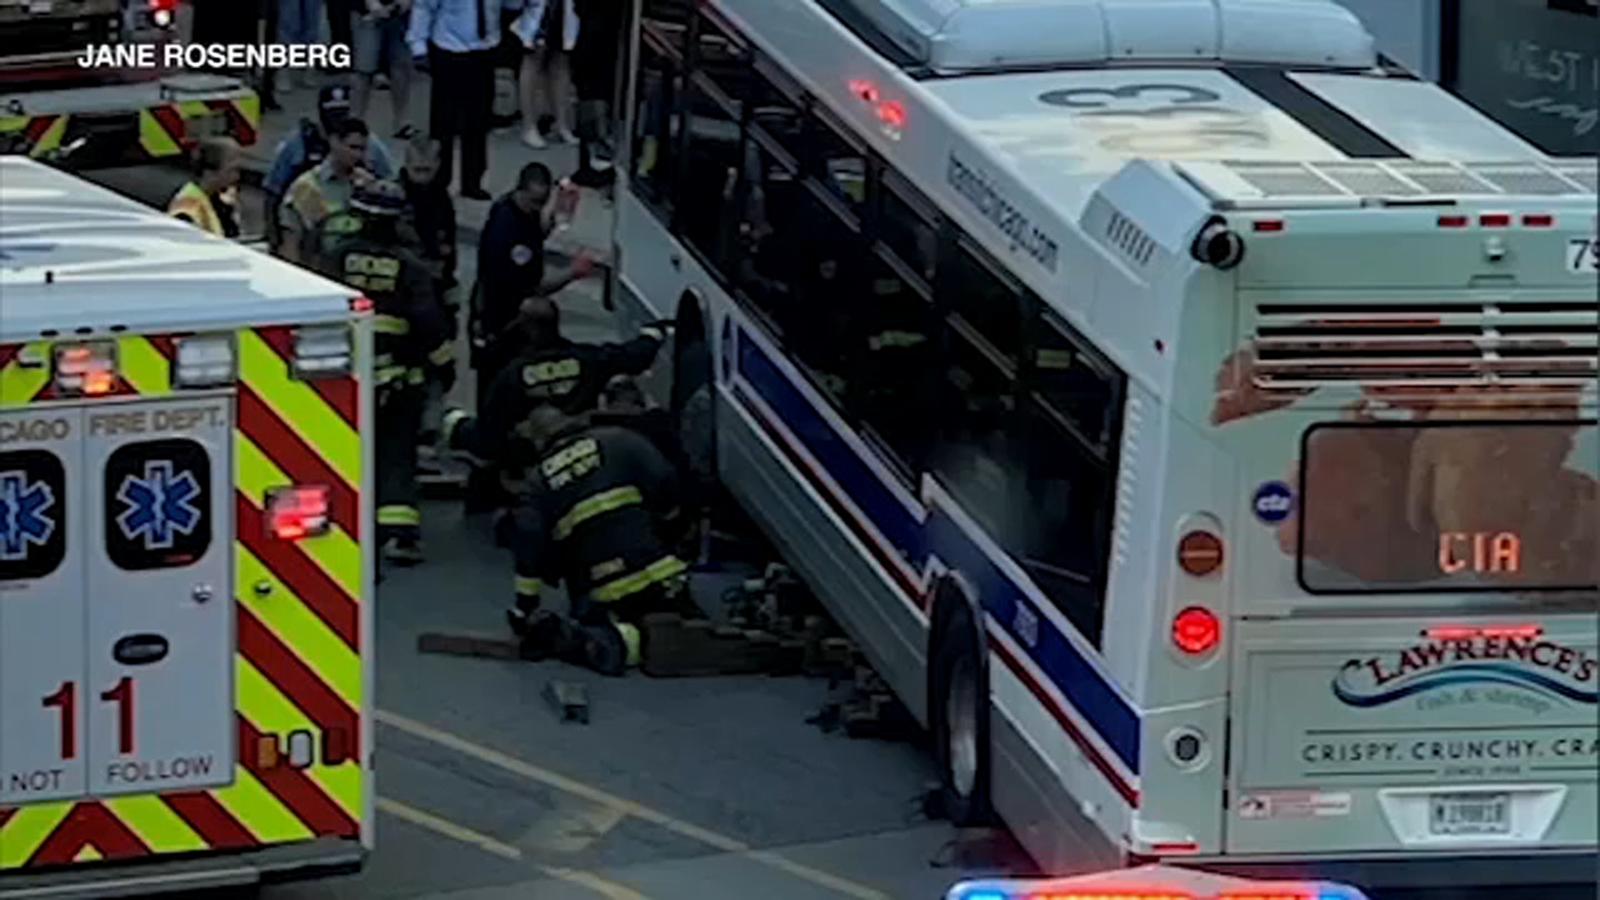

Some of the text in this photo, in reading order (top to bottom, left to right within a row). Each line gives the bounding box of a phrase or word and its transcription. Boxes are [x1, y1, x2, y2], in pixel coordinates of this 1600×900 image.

[90, 411, 146, 436] FIRE
[153, 406, 224, 432] DEPT.
[1366, 636, 1597, 685] LAWRENCE'S
[1301, 743, 1403, 762] CRISPY.
[1411, 740, 1544, 761] CRUNCHY.
[11, 769, 62, 791] NOT
[107, 757, 213, 783] FOLLOW
